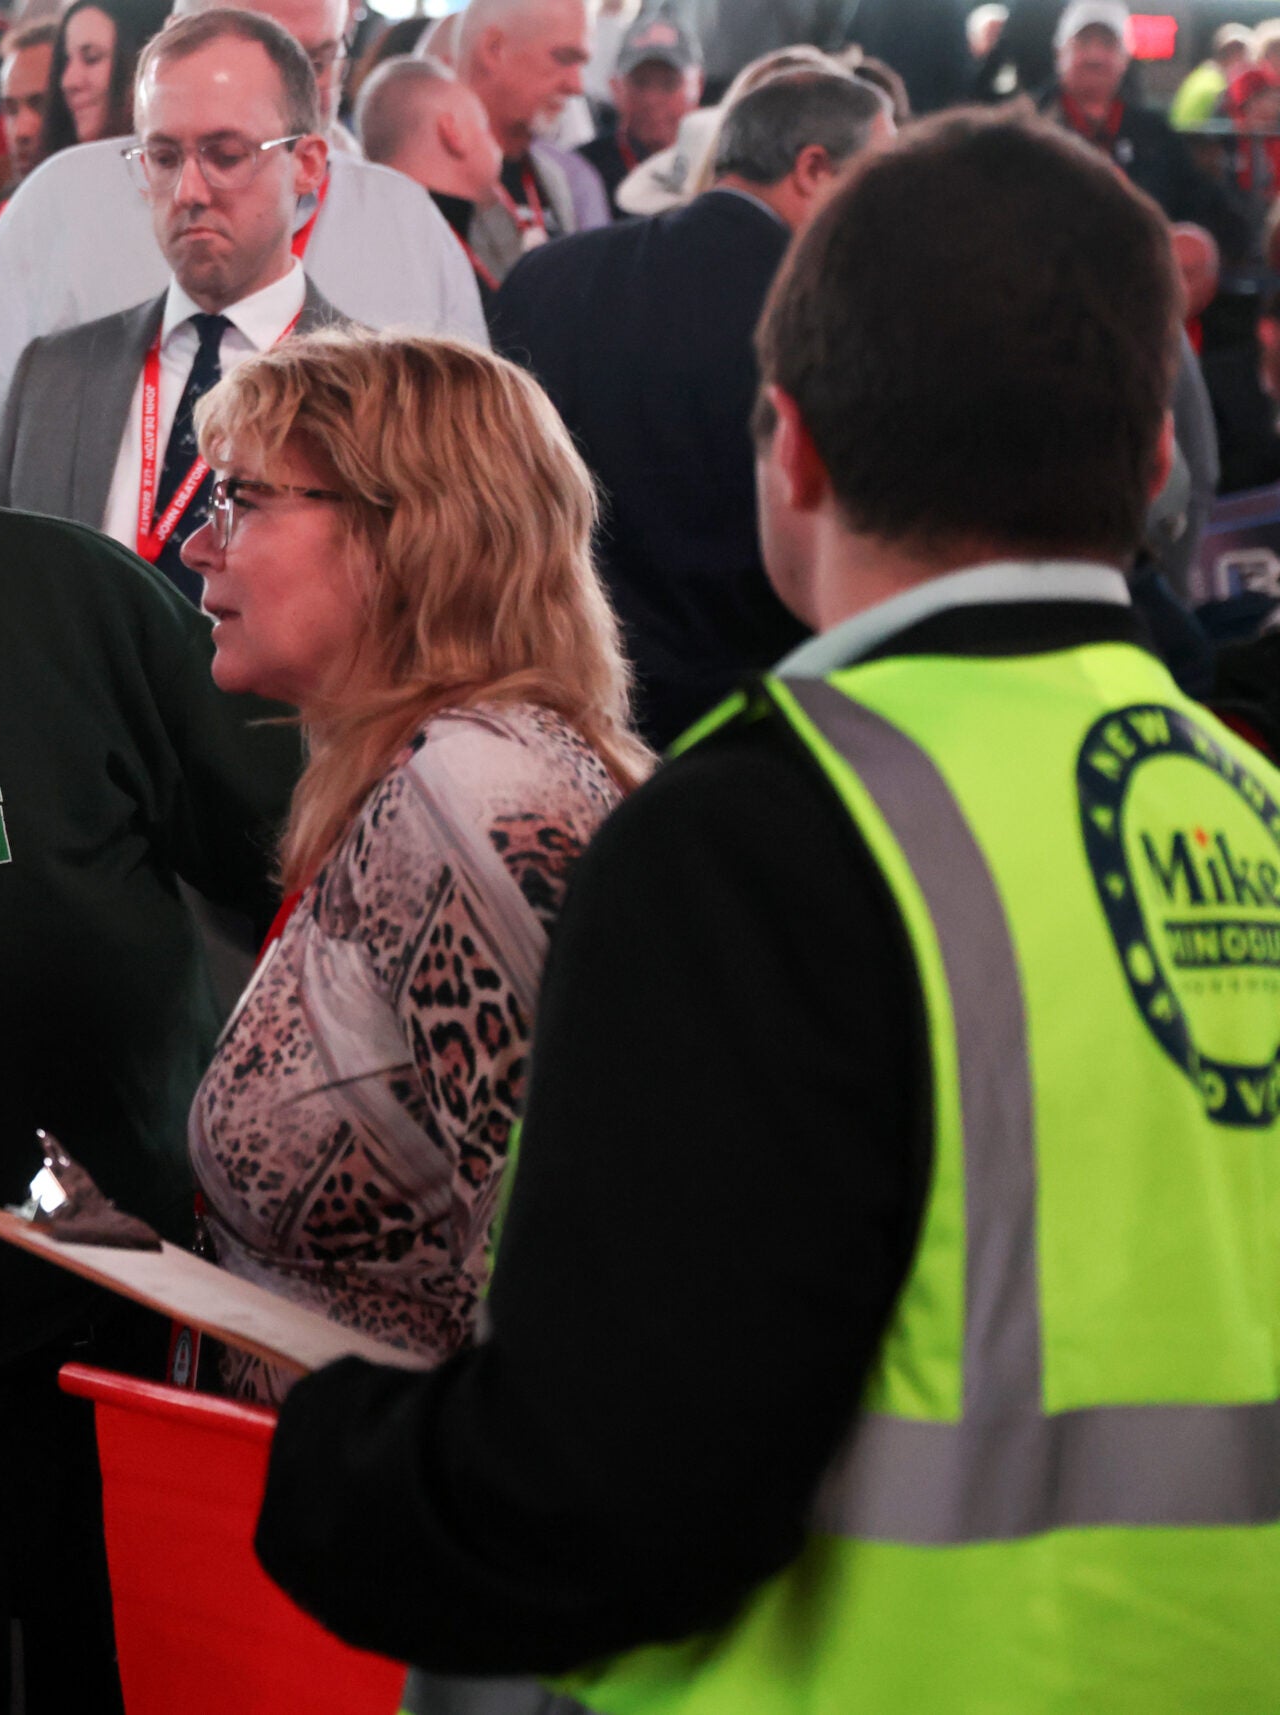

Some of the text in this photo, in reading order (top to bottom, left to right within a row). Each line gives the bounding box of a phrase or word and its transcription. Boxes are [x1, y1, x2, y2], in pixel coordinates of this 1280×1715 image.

[157, 462, 207, 541] JOHN DEATON
[1141, 827, 1280, 905] Mike
